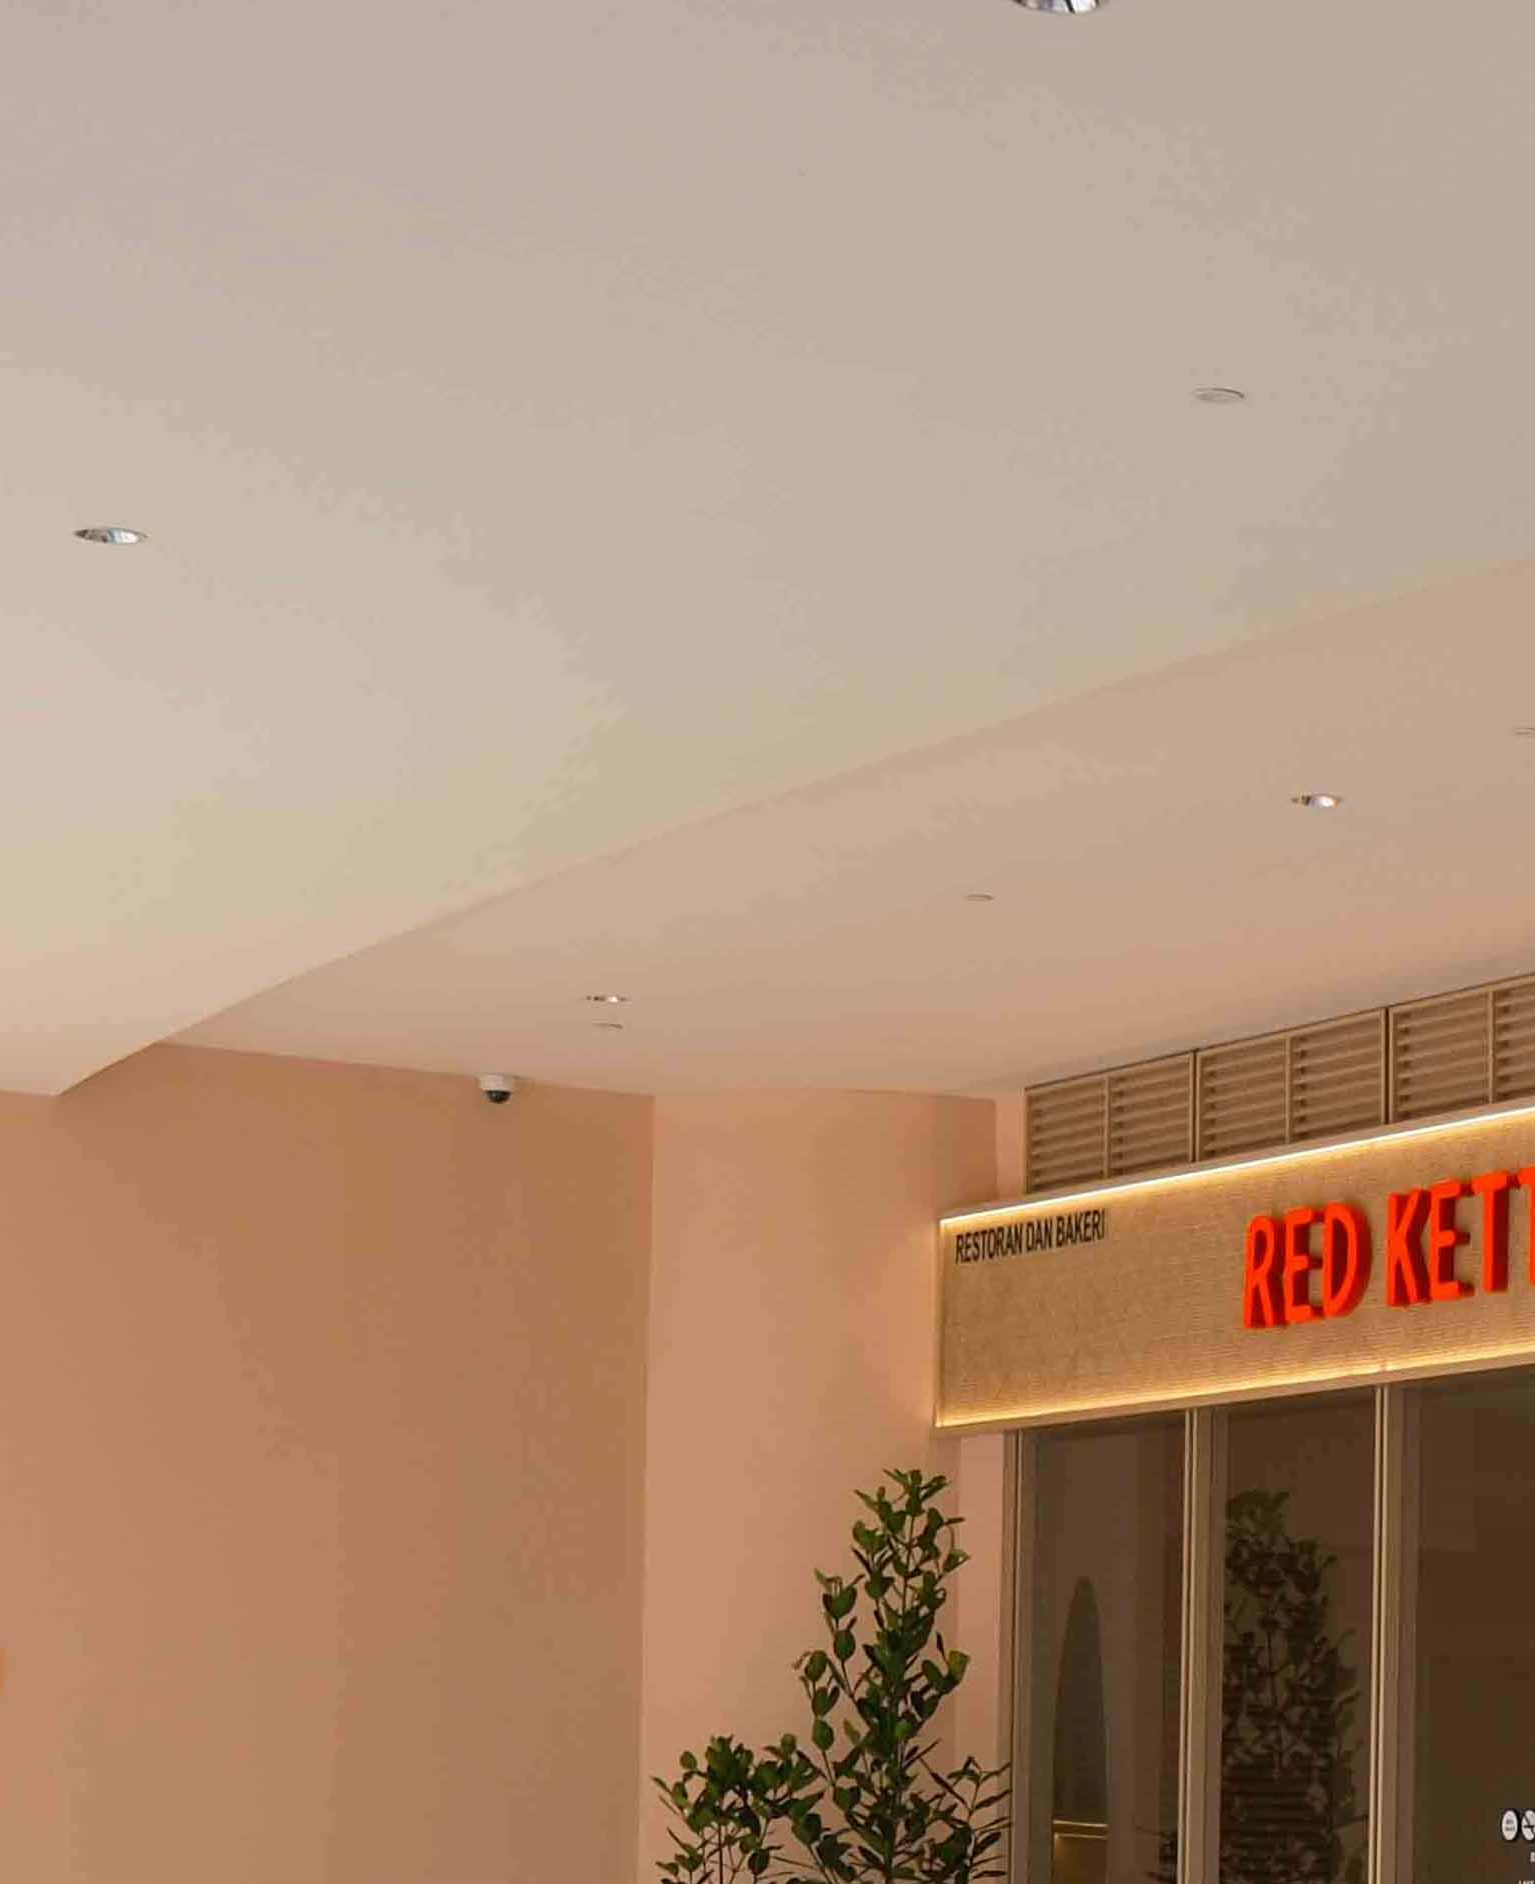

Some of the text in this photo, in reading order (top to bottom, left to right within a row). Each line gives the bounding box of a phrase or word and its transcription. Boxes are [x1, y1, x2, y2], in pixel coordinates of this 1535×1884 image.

[955, 1208, 1106, 1264] RESTORAN DAN BAKERI
[1244, 1203, 1371, 1329] RED
